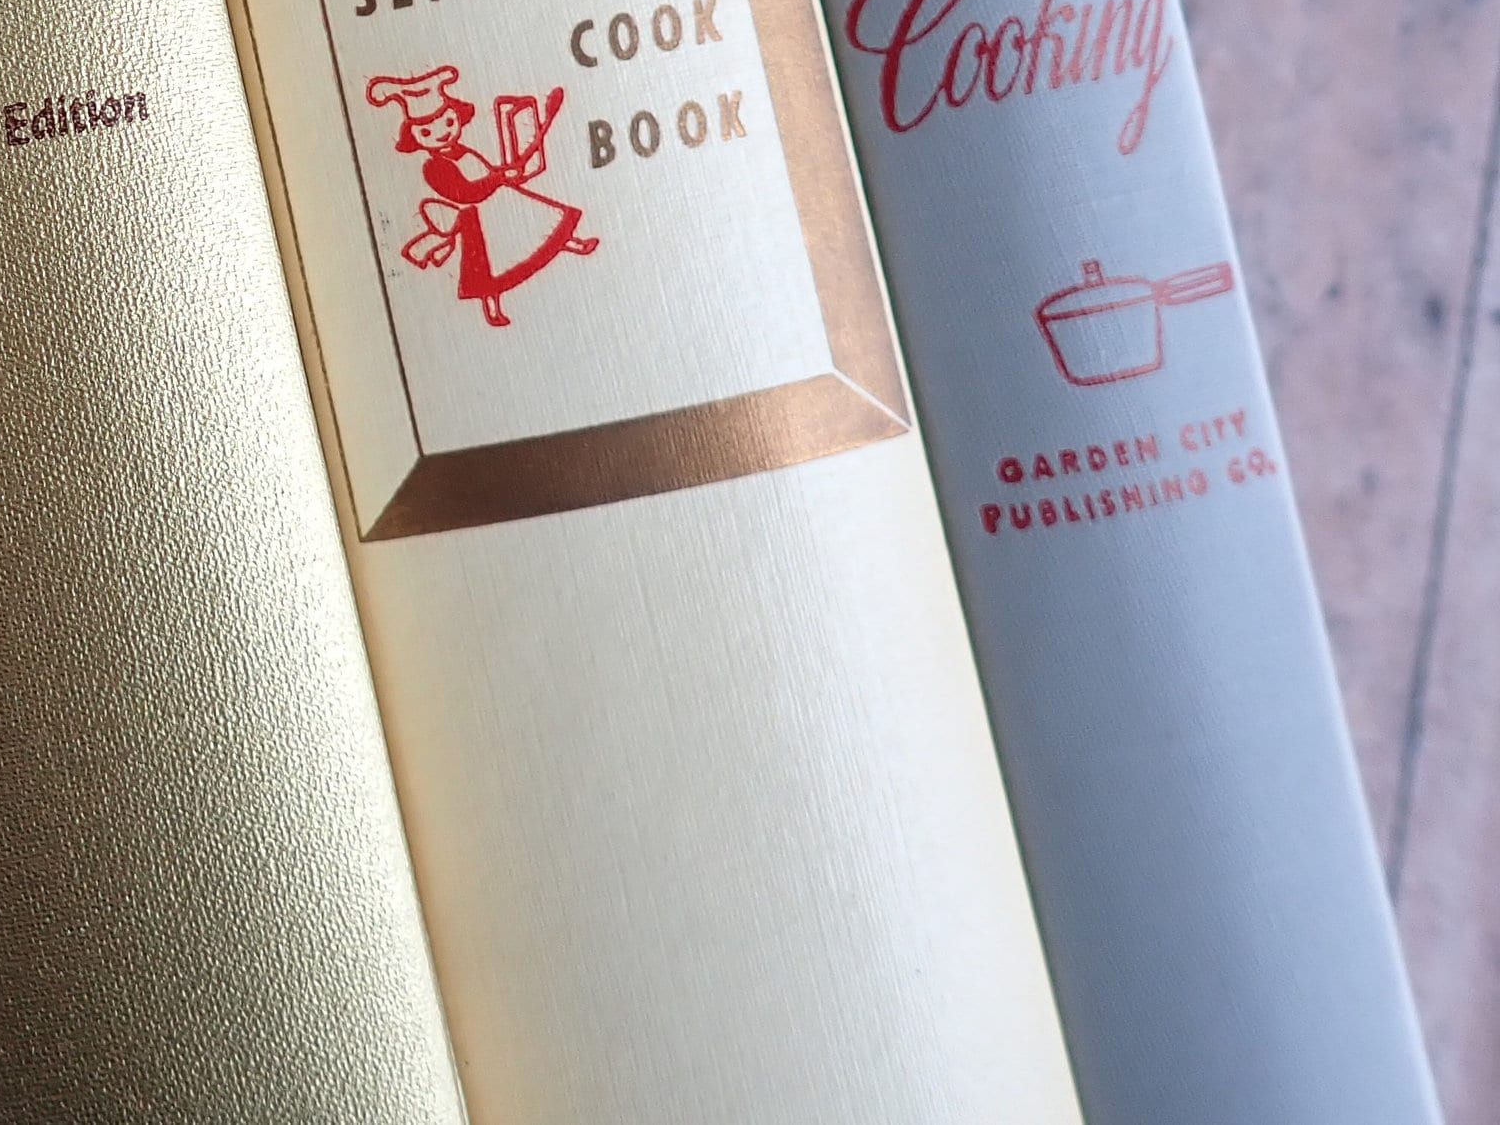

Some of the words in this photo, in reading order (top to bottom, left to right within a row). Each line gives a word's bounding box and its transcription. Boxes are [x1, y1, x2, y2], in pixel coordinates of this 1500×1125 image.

[4, 89, 149, 147] Edition
[588, 90, 748, 170] BOOK
[996, 434, 1160, 485] GARDEN
[1179, 407, 1246, 452] CITY
[979, 468, 1210, 536] PUBLISHING
